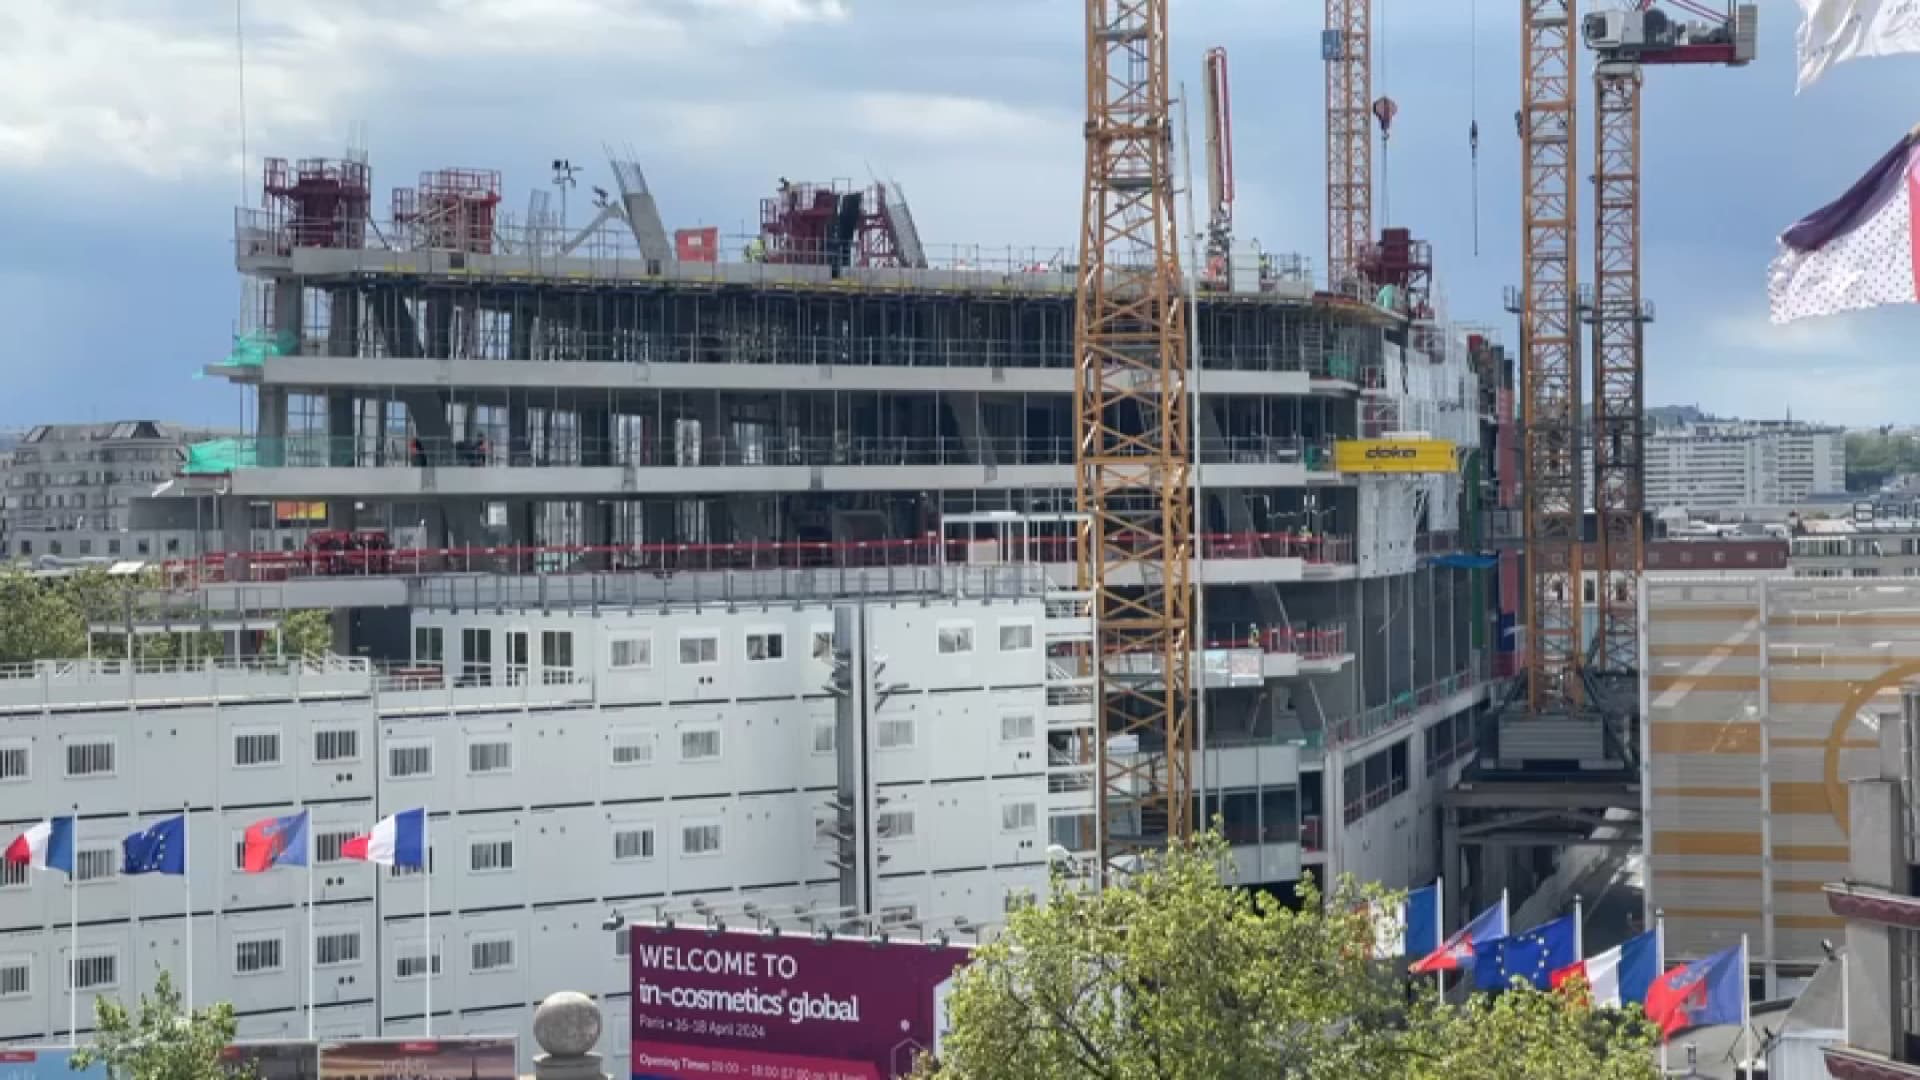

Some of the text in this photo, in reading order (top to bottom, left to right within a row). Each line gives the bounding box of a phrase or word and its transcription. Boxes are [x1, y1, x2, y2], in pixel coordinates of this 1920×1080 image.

[640, 944, 798, 979] WELCOME TO
[788, 991, 860, 1024] global
[640, 1013, 766, 1038] Paris 16-18 April 2024
[640, 1053, 680, 1071] Opening
[682, 1057, 710, 1072] Times
